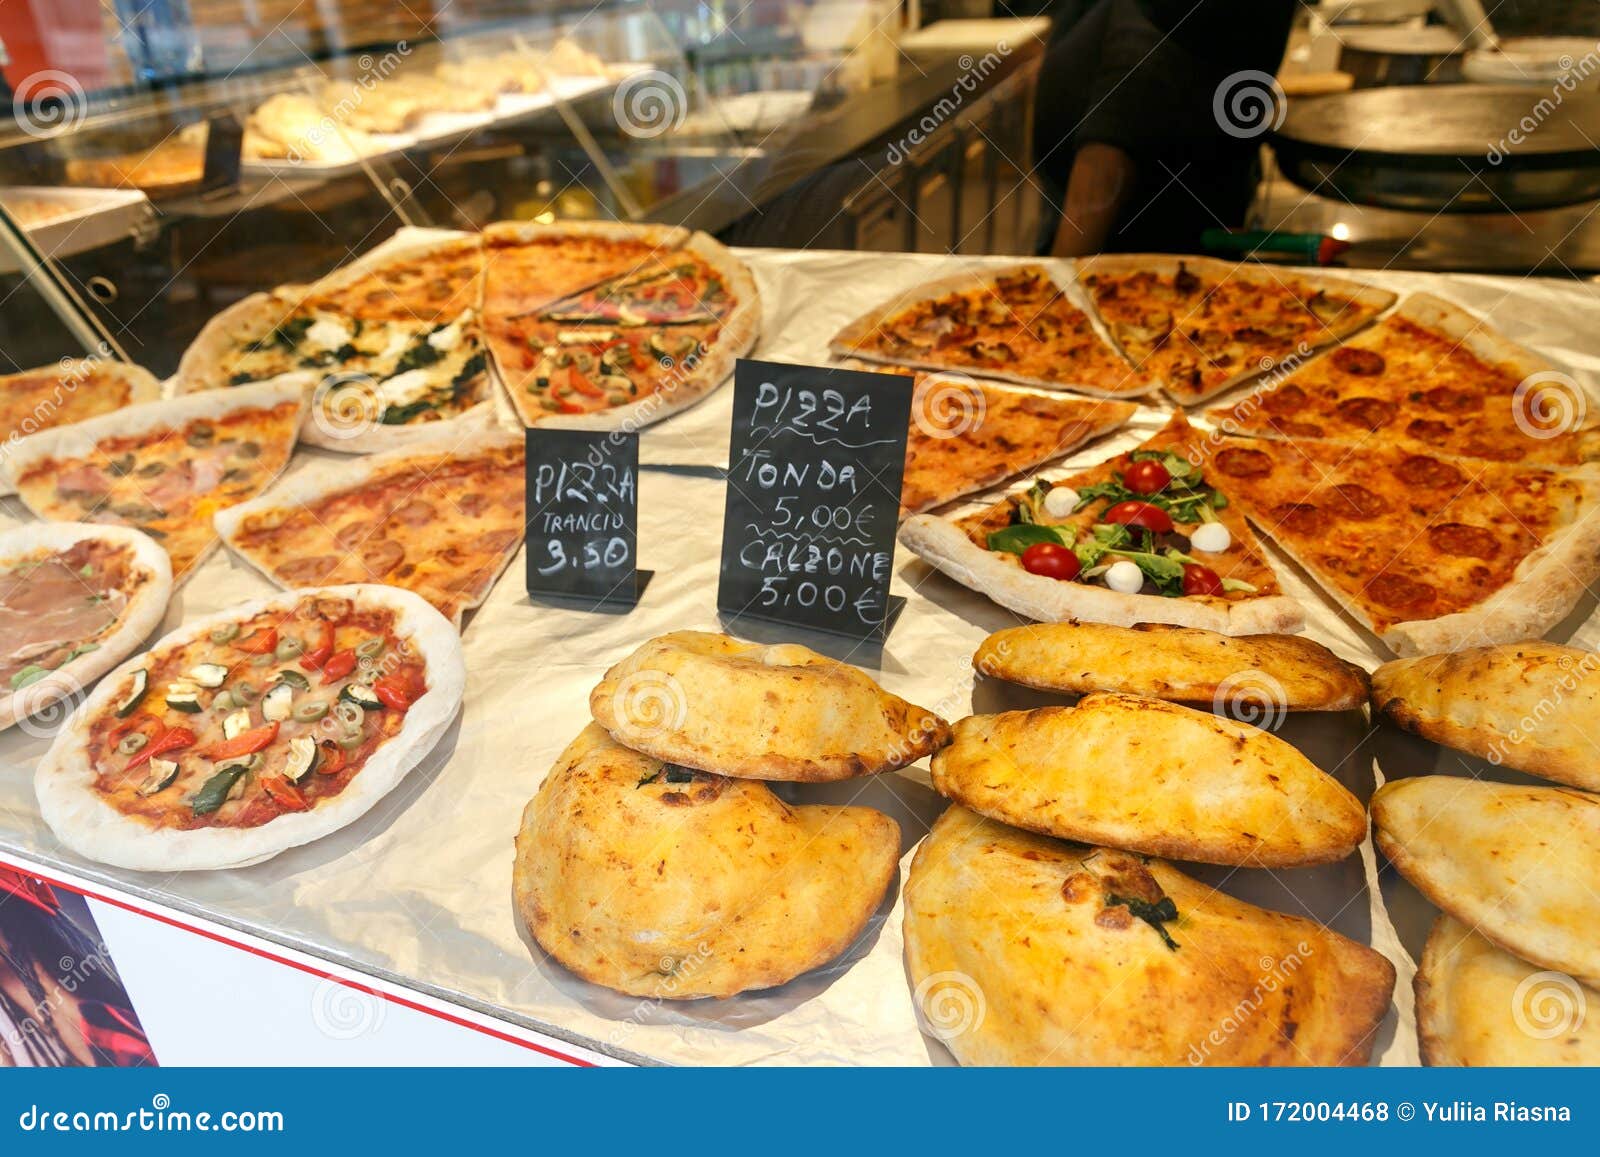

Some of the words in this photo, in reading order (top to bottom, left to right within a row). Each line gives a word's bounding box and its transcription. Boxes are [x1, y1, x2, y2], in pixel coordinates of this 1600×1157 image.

[751, 382, 871, 431] PIZZA
[535, 462, 634, 505] PIZZA
[743, 449, 856, 494] TONDA
[740, 540, 889, 580] CALZONE
